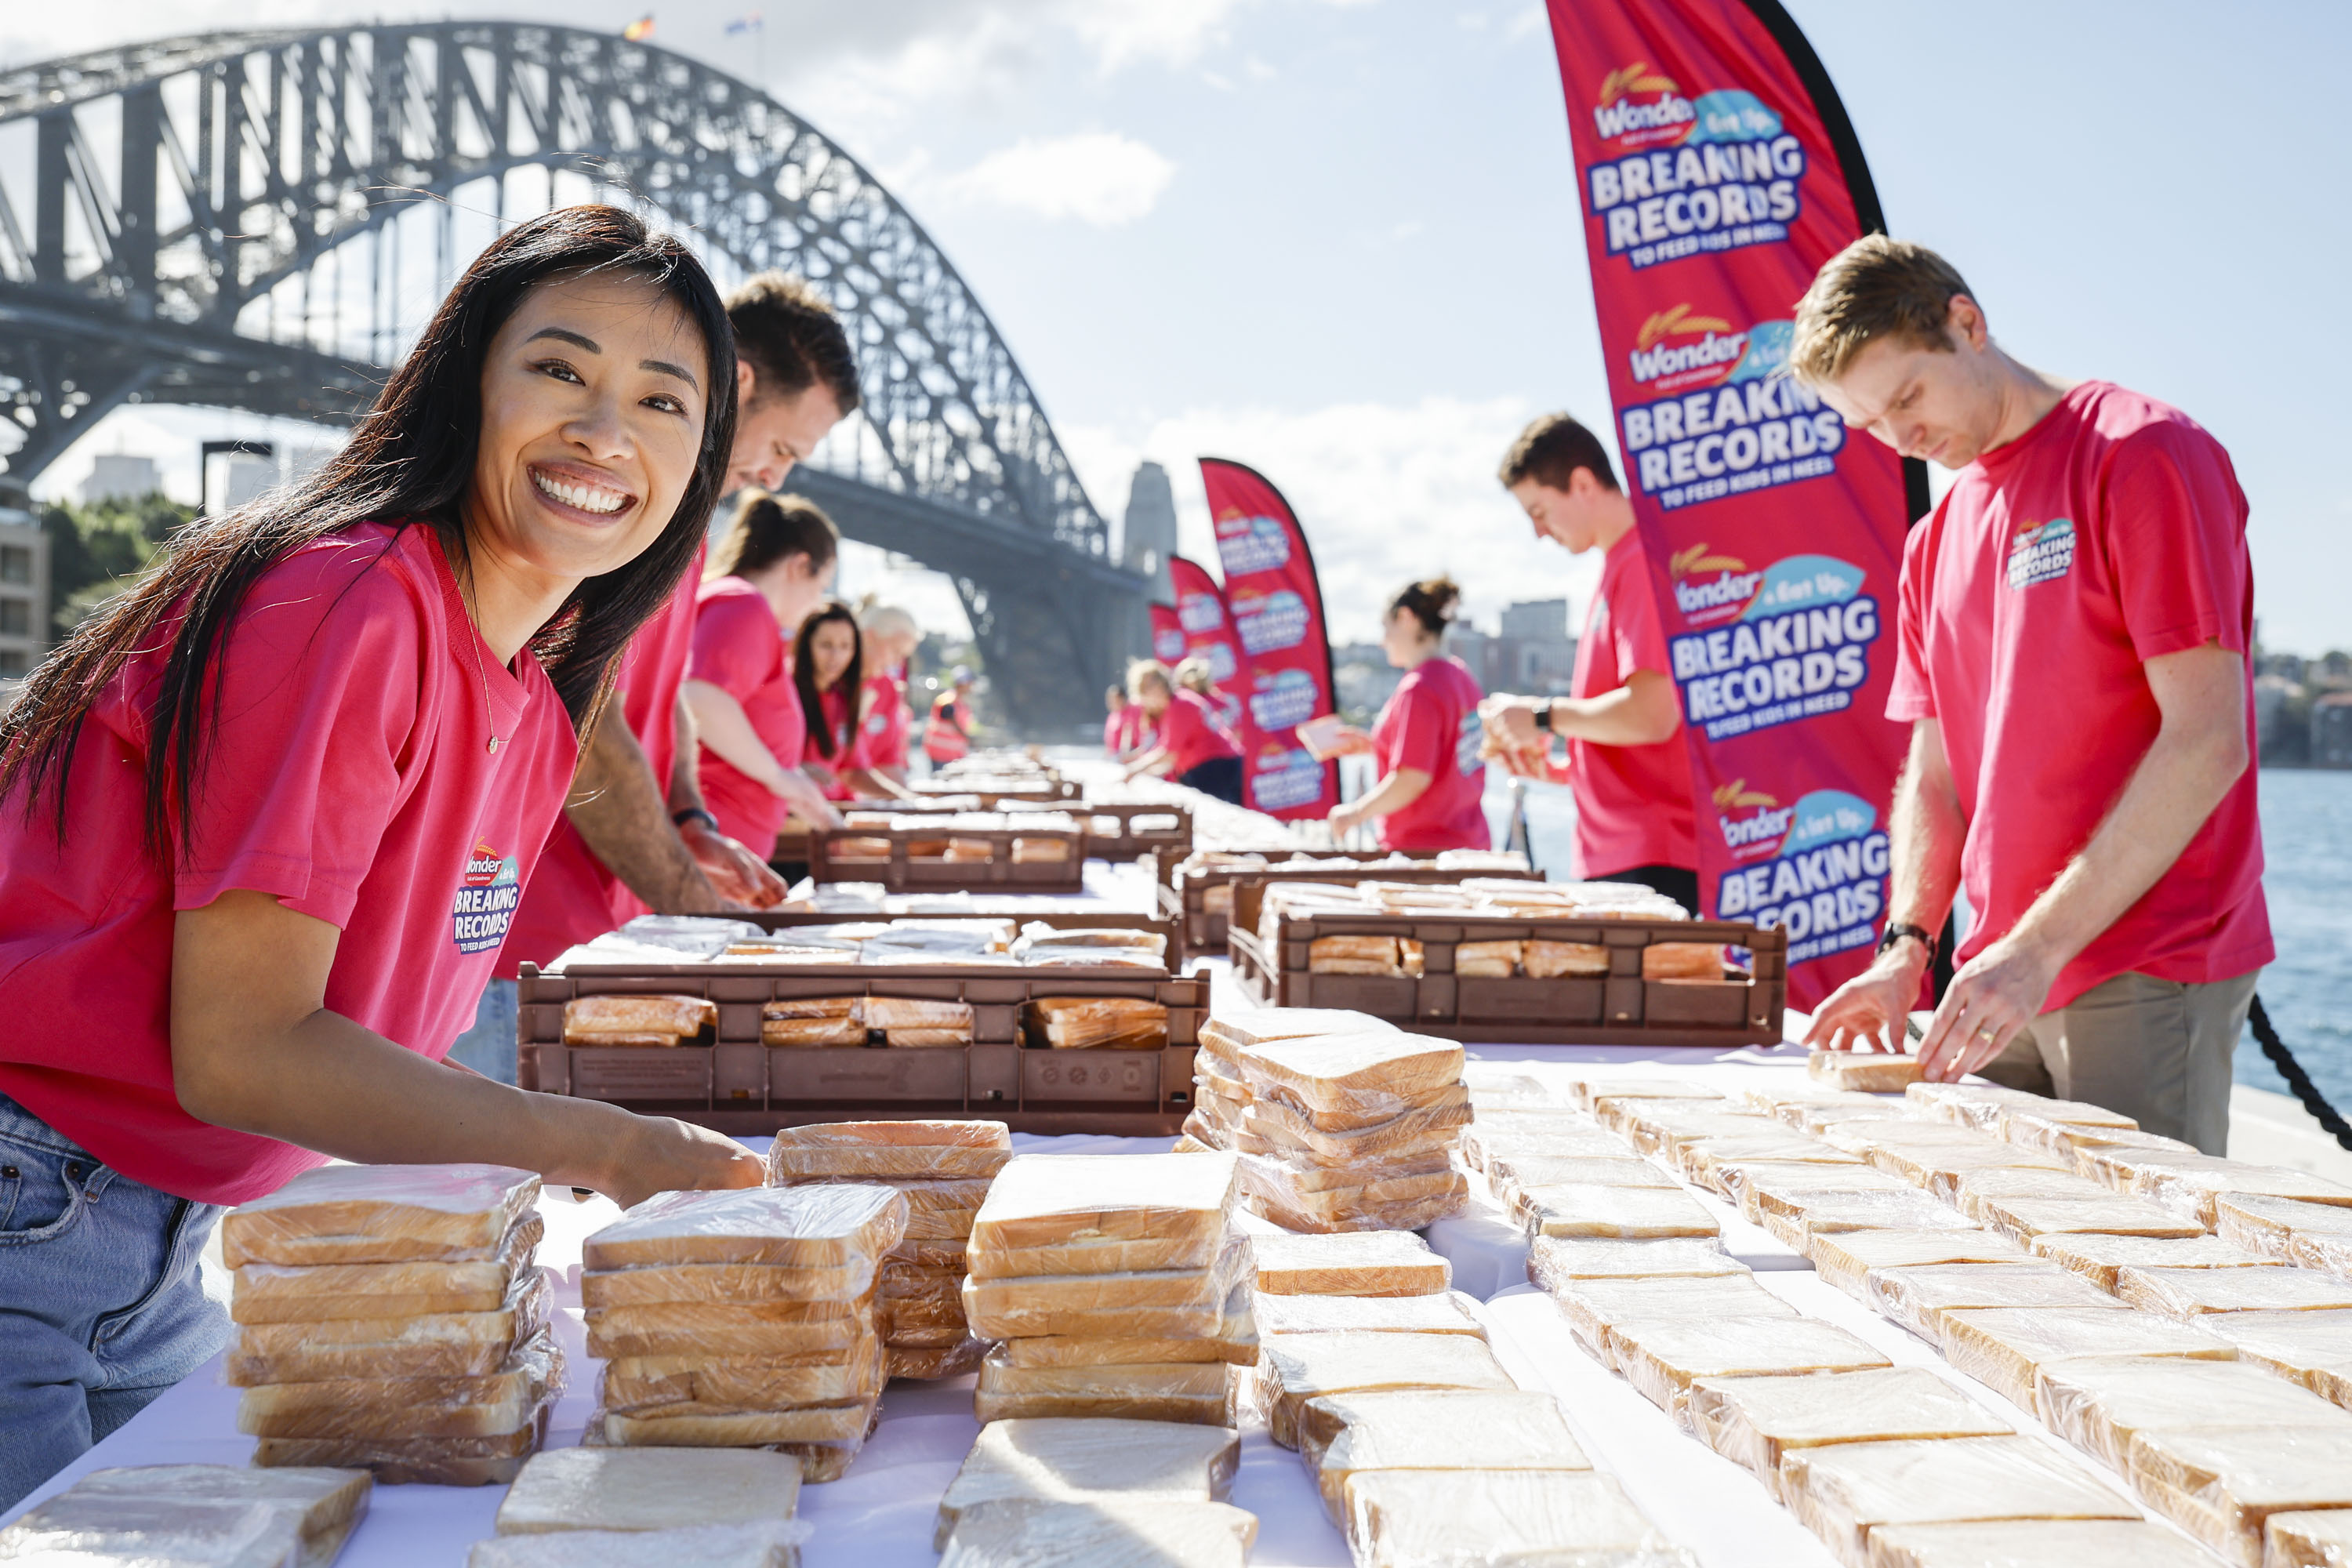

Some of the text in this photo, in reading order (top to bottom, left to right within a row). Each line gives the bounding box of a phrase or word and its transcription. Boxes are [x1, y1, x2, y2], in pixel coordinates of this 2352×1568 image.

[1595, 93, 1693, 139] Wonde
[1608, 180, 1797, 252] RECORDS
[1630, 246, 1655, 267] TO
[1656, 235, 1699, 261] FEED
[1630, 330, 1748, 383] Wonder
[1624, 377, 1820, 452] BREAKIN
[1639, 412, 1842, 492] RECORDS
[1661, 488, 1684, 509] TO
[1686, 477, 1729, 504] FEED
[1729, 467, 1771, 493] KIDS
[1771, 463, 1792, 484] IN
[1687, 645, 1864, 721] RECORDS
[1803, 690, 1851, 716] NEED
[453, 886, 517, 913] BREAKING
[455, 912, 510, 939] RECORDS
[460, 942, 467, 952] TO
[467, 942, 478, 951] FEED
